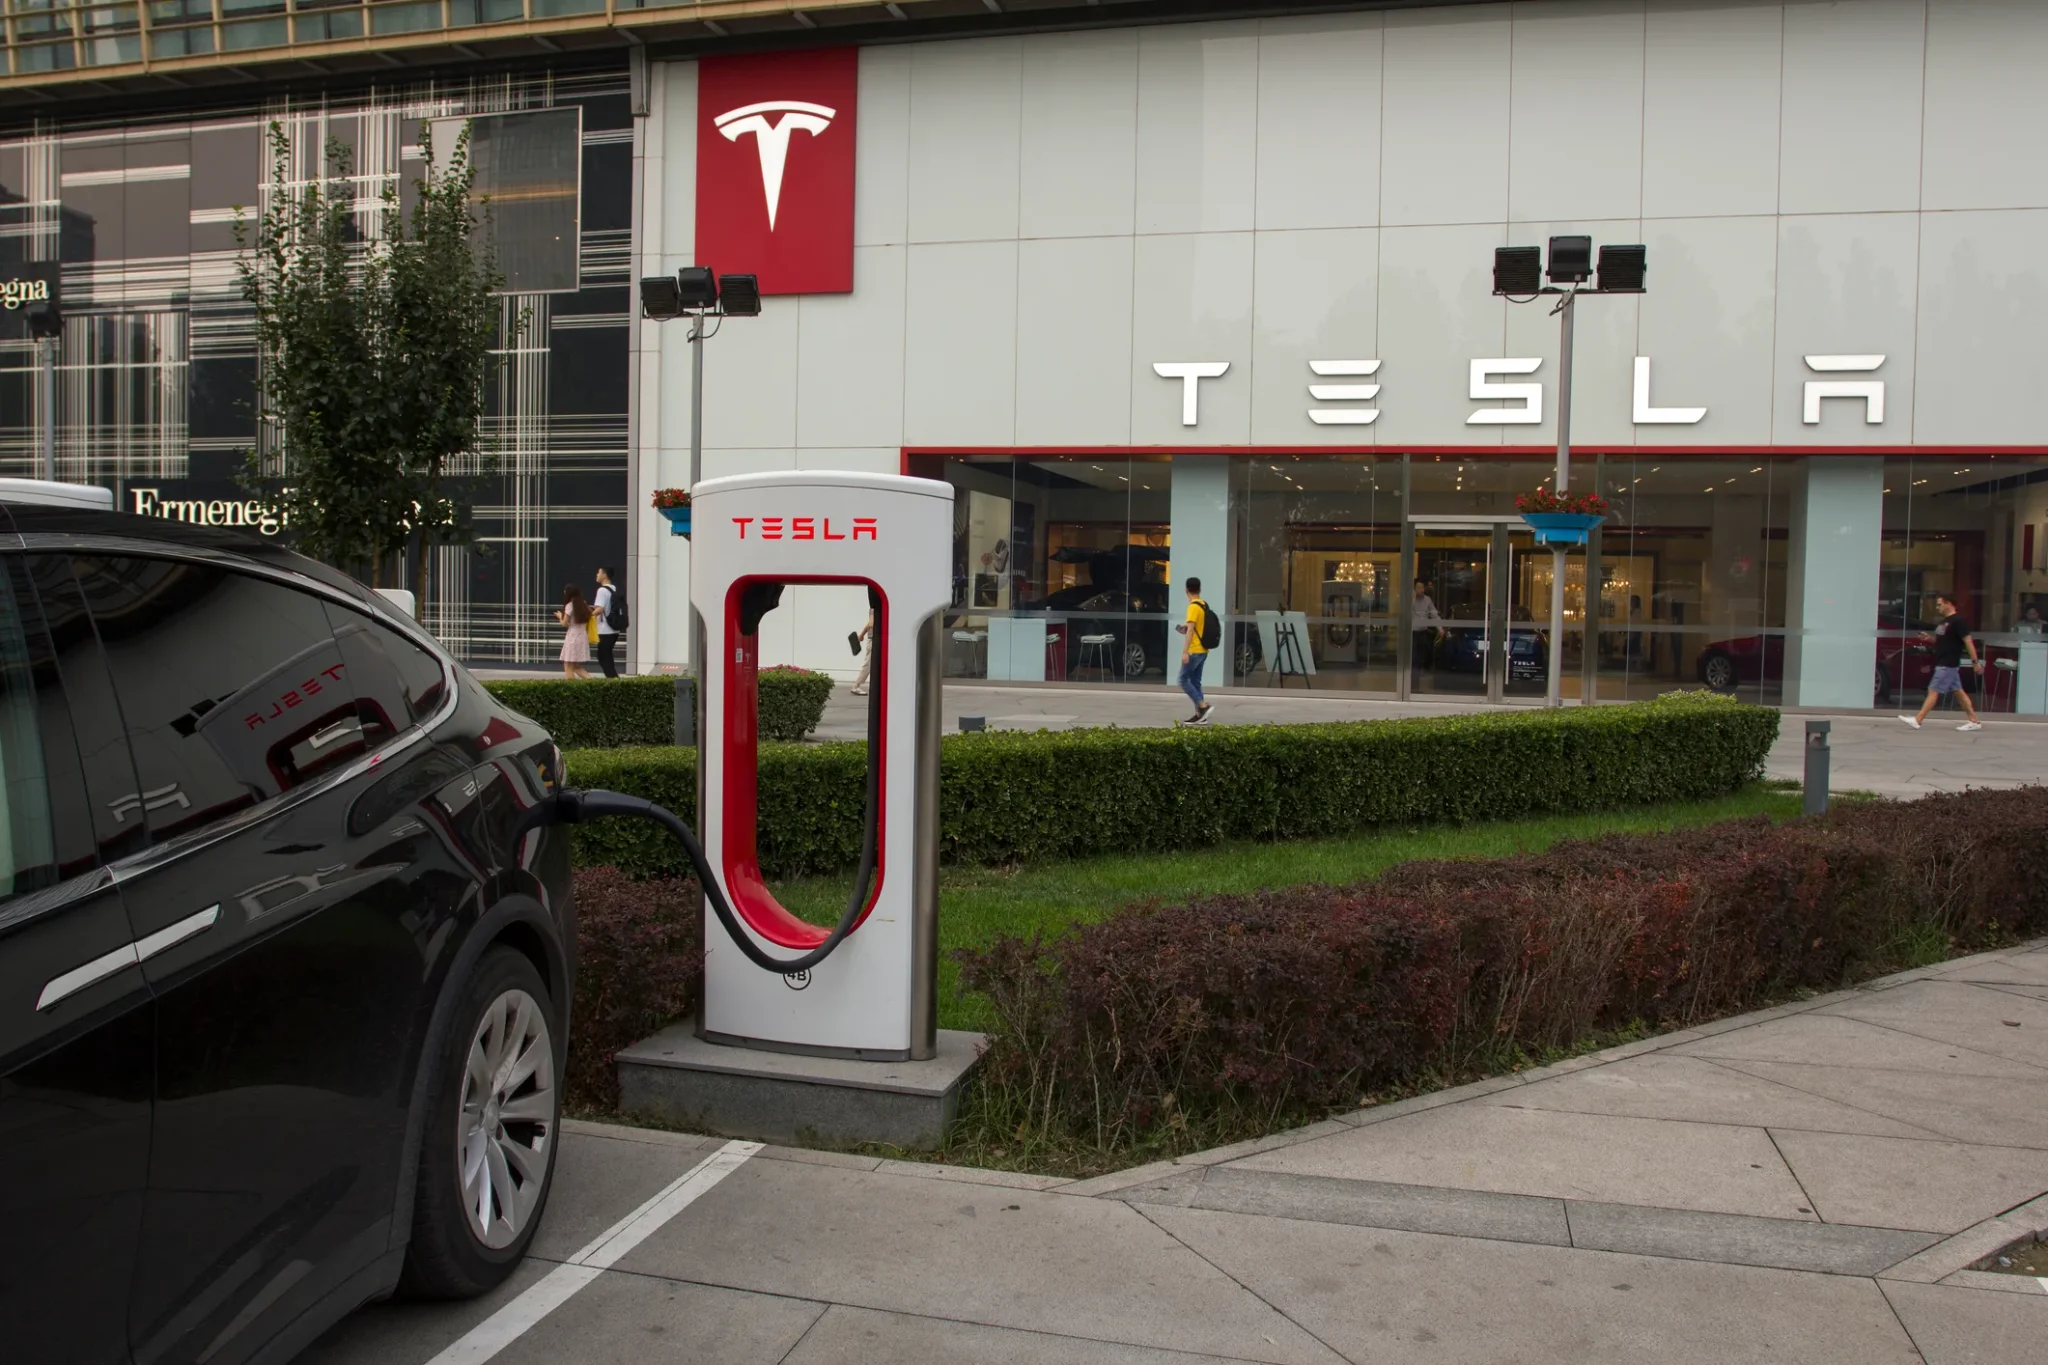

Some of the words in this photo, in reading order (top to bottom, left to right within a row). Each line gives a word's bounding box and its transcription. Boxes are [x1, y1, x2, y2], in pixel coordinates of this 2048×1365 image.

[1153, 354, 1887, 426] TESLA
[130, 487, 318, 535] Ermenegi
[731, 517, 878, 541] TESLA
